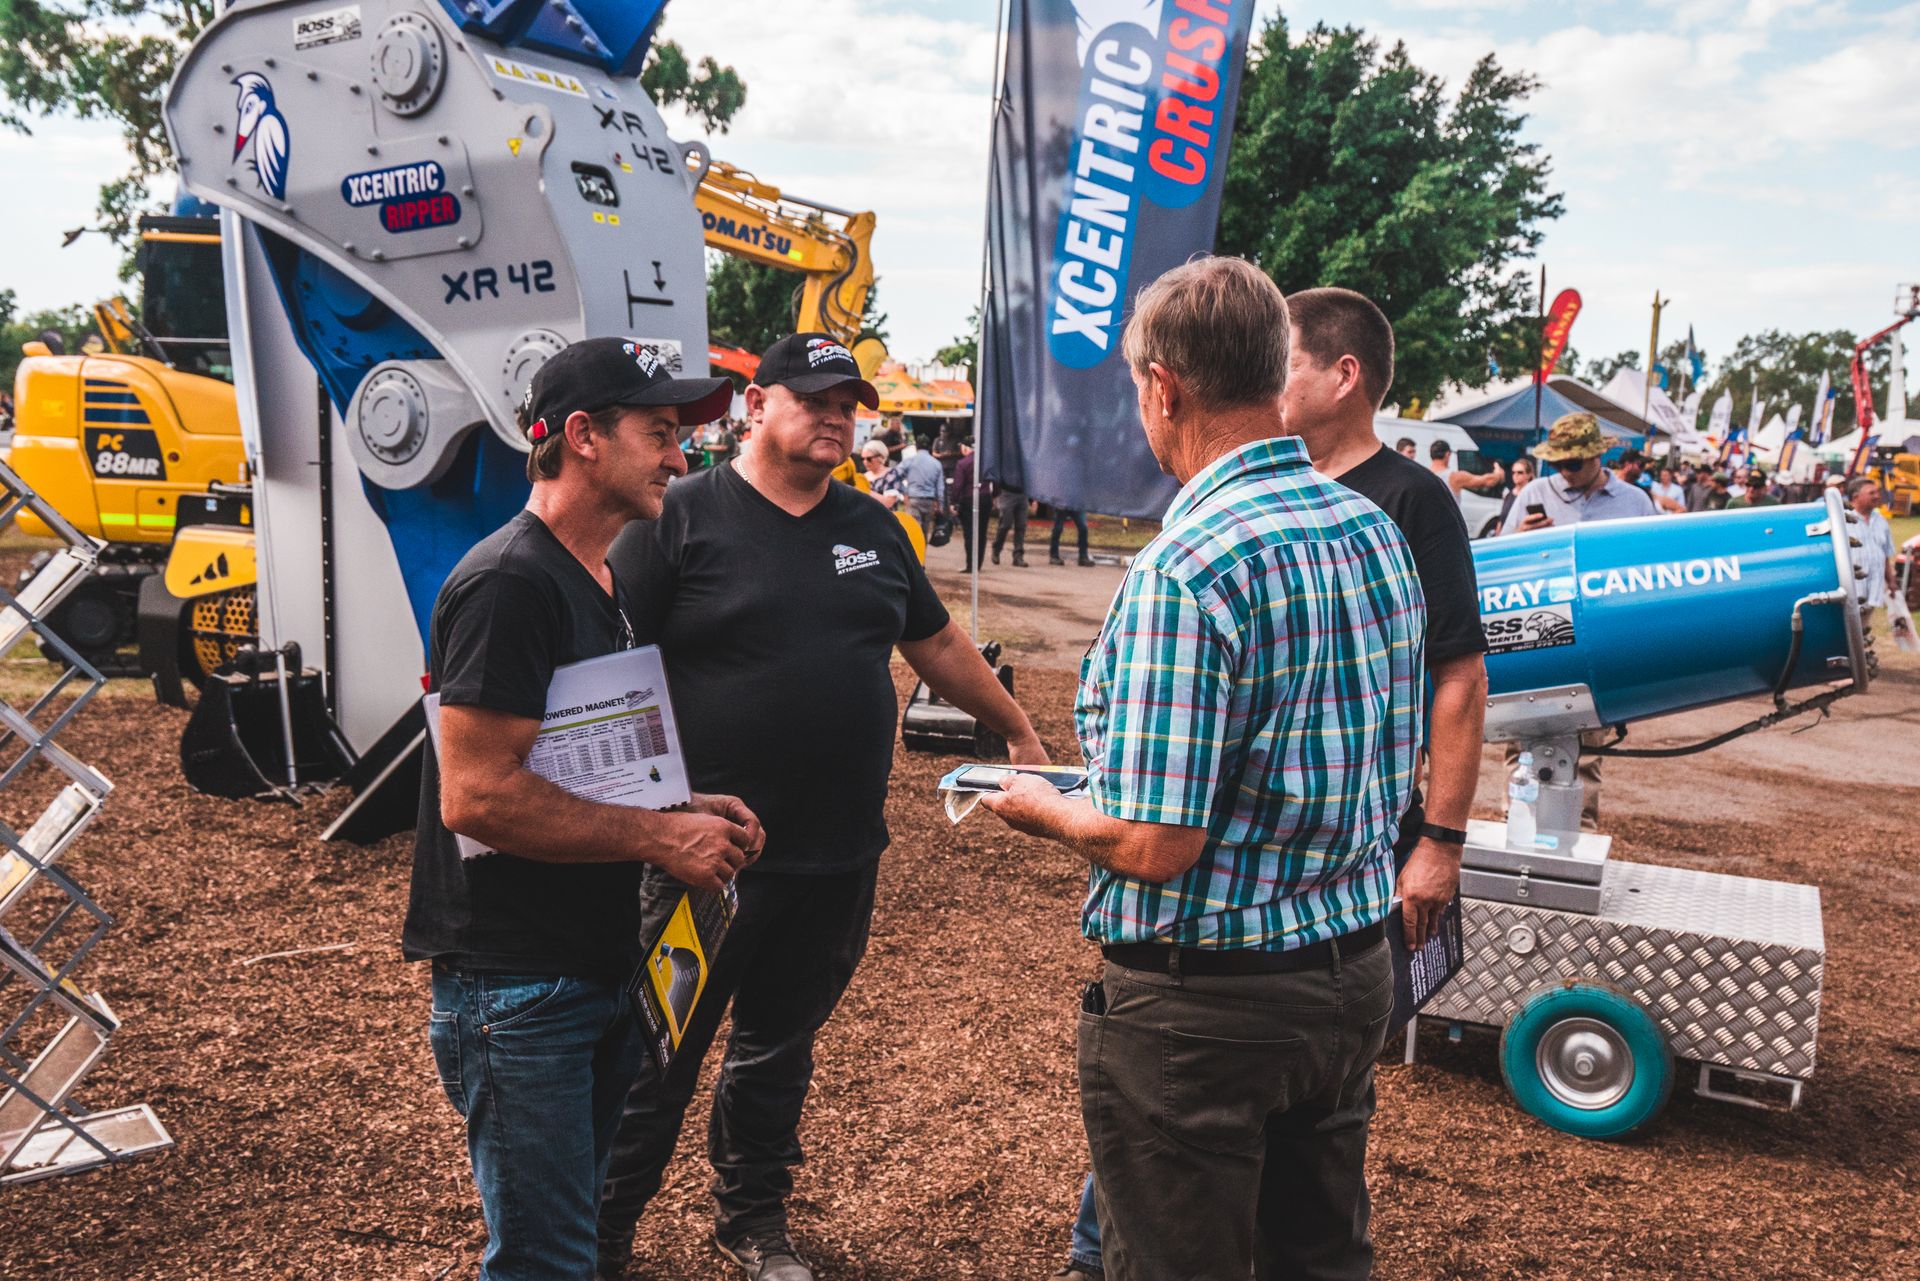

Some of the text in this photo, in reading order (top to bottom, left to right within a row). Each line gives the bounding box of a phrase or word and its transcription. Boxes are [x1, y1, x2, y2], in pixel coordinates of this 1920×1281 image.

[297, 17, 335, 35] BOSS
[592, 103, 648, 138] XR
[631, 142, 674, 175] 42
[348, 163, 439, 204] XCENTRIC
[1052, 39, 1152, 350] XCENTRIC
[385, 196, 456, 230] RIPPER
[699, 209, 792, 255] OMATSU
[441, 259, 556, 304] XR 42
[97, 433, 124, 451] PC
[95, 451, 160, 475] 88MR
[835, 550, 878, 570] BOSS
[1478, 555, 1742, 612] RAY CANNON
[543, 706, 584, 721] OWERED
